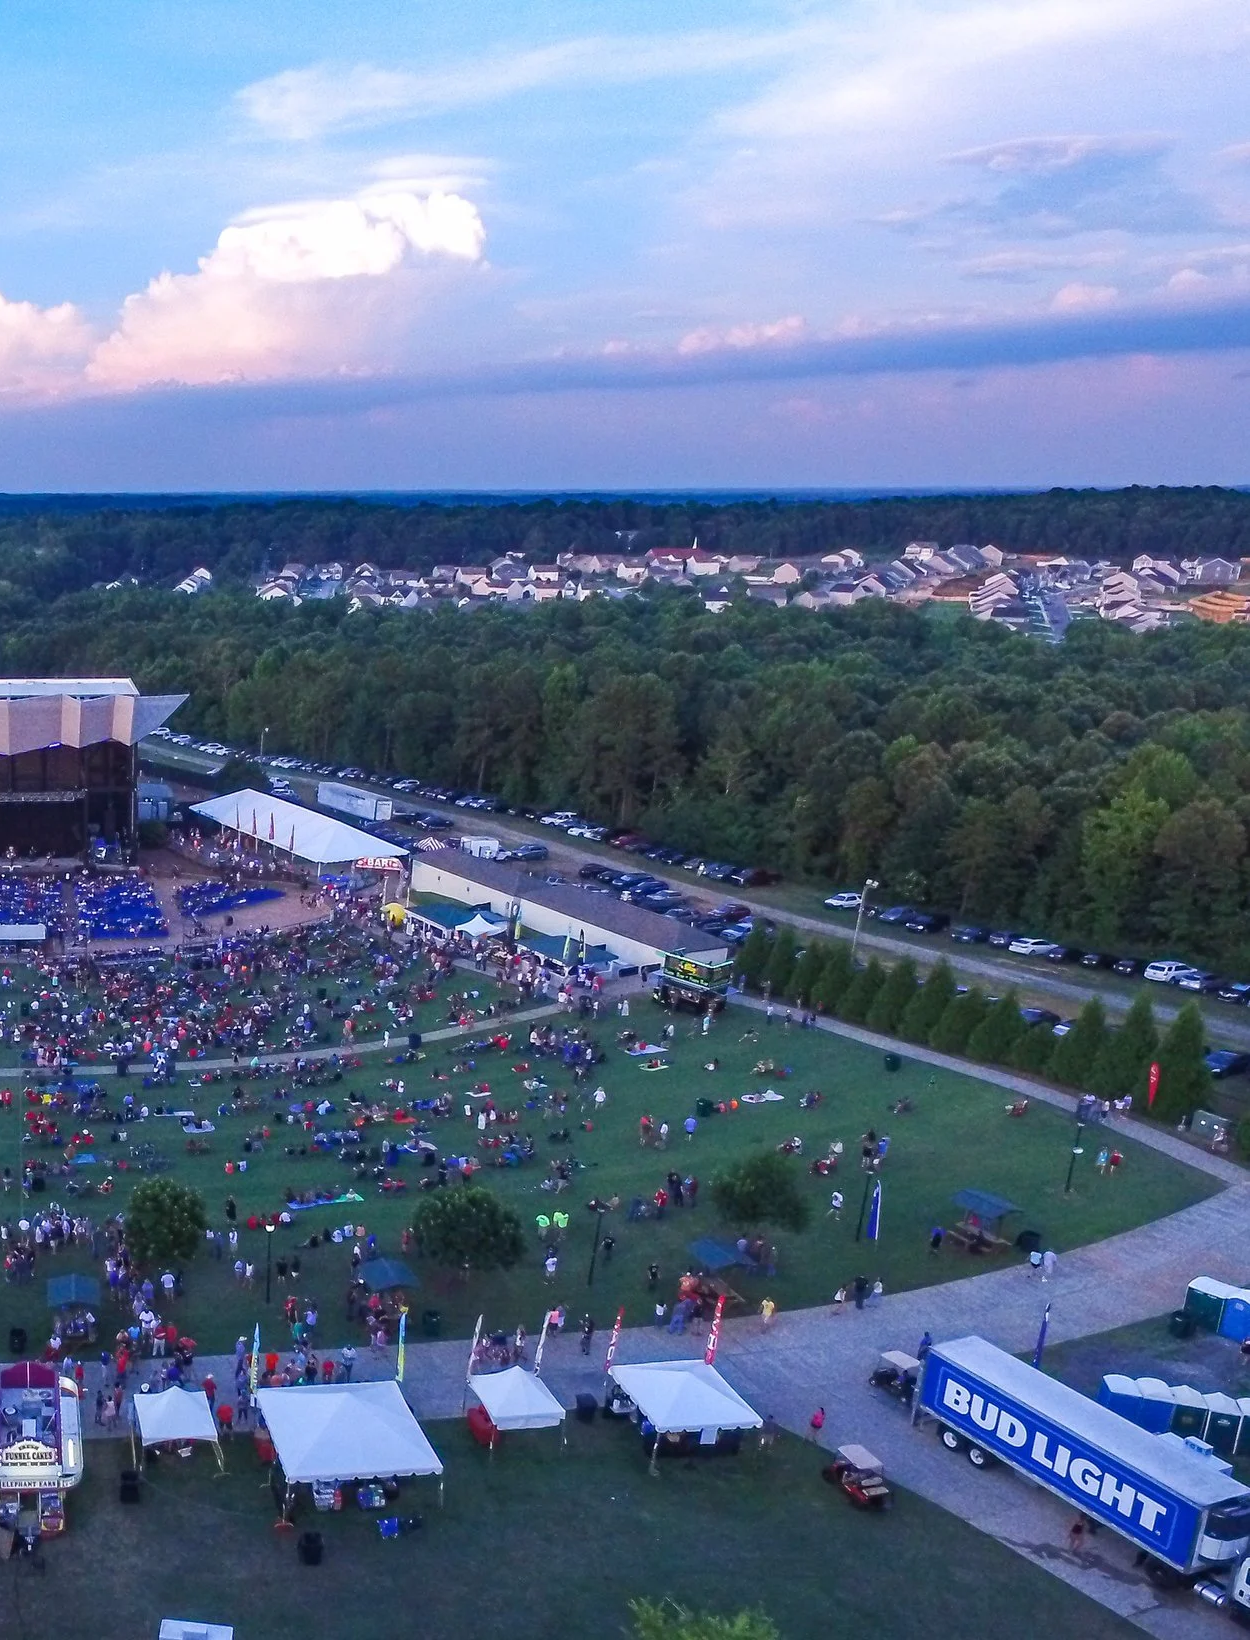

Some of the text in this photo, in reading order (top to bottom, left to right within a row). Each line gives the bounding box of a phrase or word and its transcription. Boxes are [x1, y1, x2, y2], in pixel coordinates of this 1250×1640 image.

[5, 1451, 53, 1460] FUNNEL CAKES
[943, 1378, 1167, 1532] BUD LIGHT
